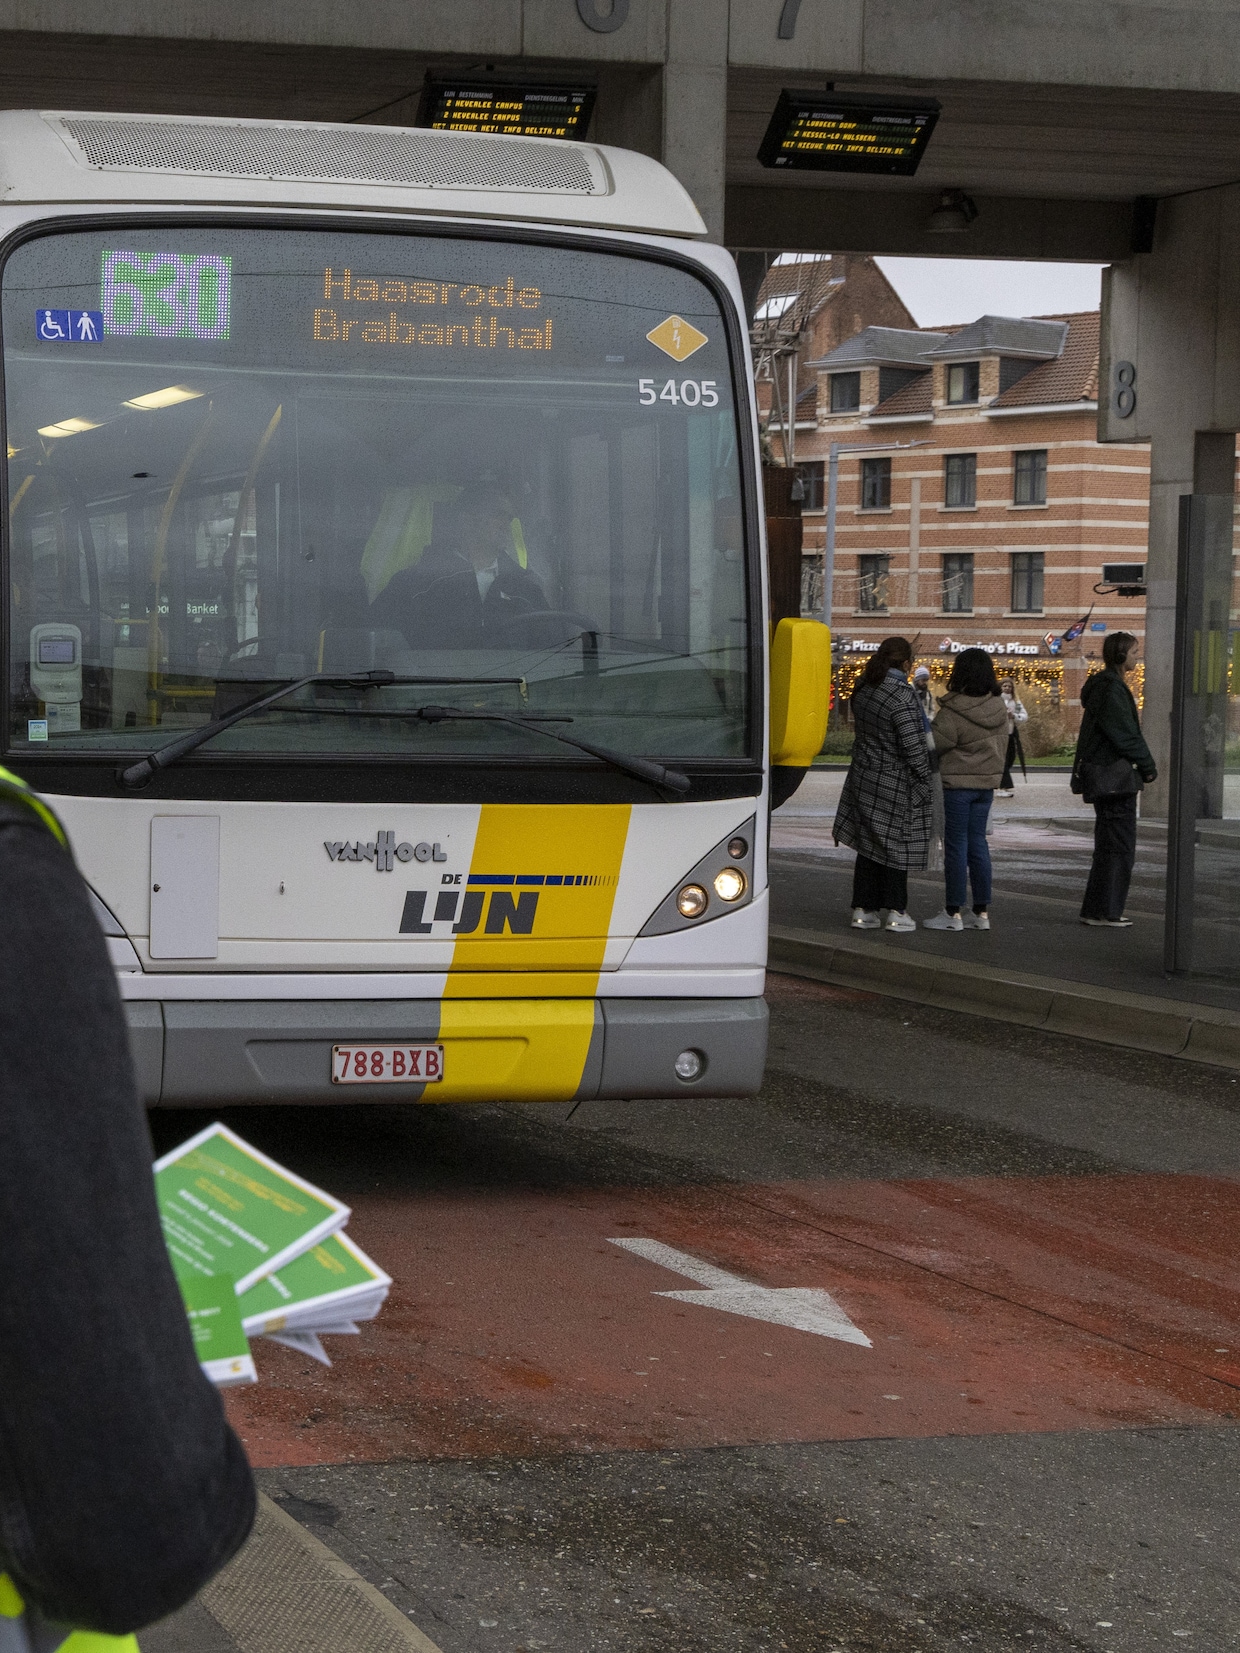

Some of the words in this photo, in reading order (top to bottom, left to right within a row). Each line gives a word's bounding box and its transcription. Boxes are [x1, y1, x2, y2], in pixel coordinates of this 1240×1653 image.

[446, 99, 452, 107] 2
[455, 100, 493, 109] HEVERLEE
[495, 101, 524, 110] CAMPUS
[443, 111, 449, 119] 2
[452, 111, 490, 121] HEVERLEE
[492, 113, 521, 122] CAMPUS
[449, 123, 478, 132] NIEUWE
[481, 124, 499, 133] NET!
[503, 126, 522, 134] INFO
[524, 127, 567, 136] DELIJN.BE
[846, 145, 864, 153] INFO
[103, 251, 231, 338] 630
[324, 267, 542, 309] Haasrode
[313, 308, 554, 350] Brabanthal
[638, 378, 720, 408] 5405
[1112, 360, 1137, 419] 8
[186, 602, 219, 615] Banket
[950, 641, 1006, 654] Doino's
[1006, 641, 1040, 655] Pizza
[441, 873, 463, 885] DE
[398, 890, 540, 934] LIJN
[337, 1049, 440, 1079] 788-BXB
